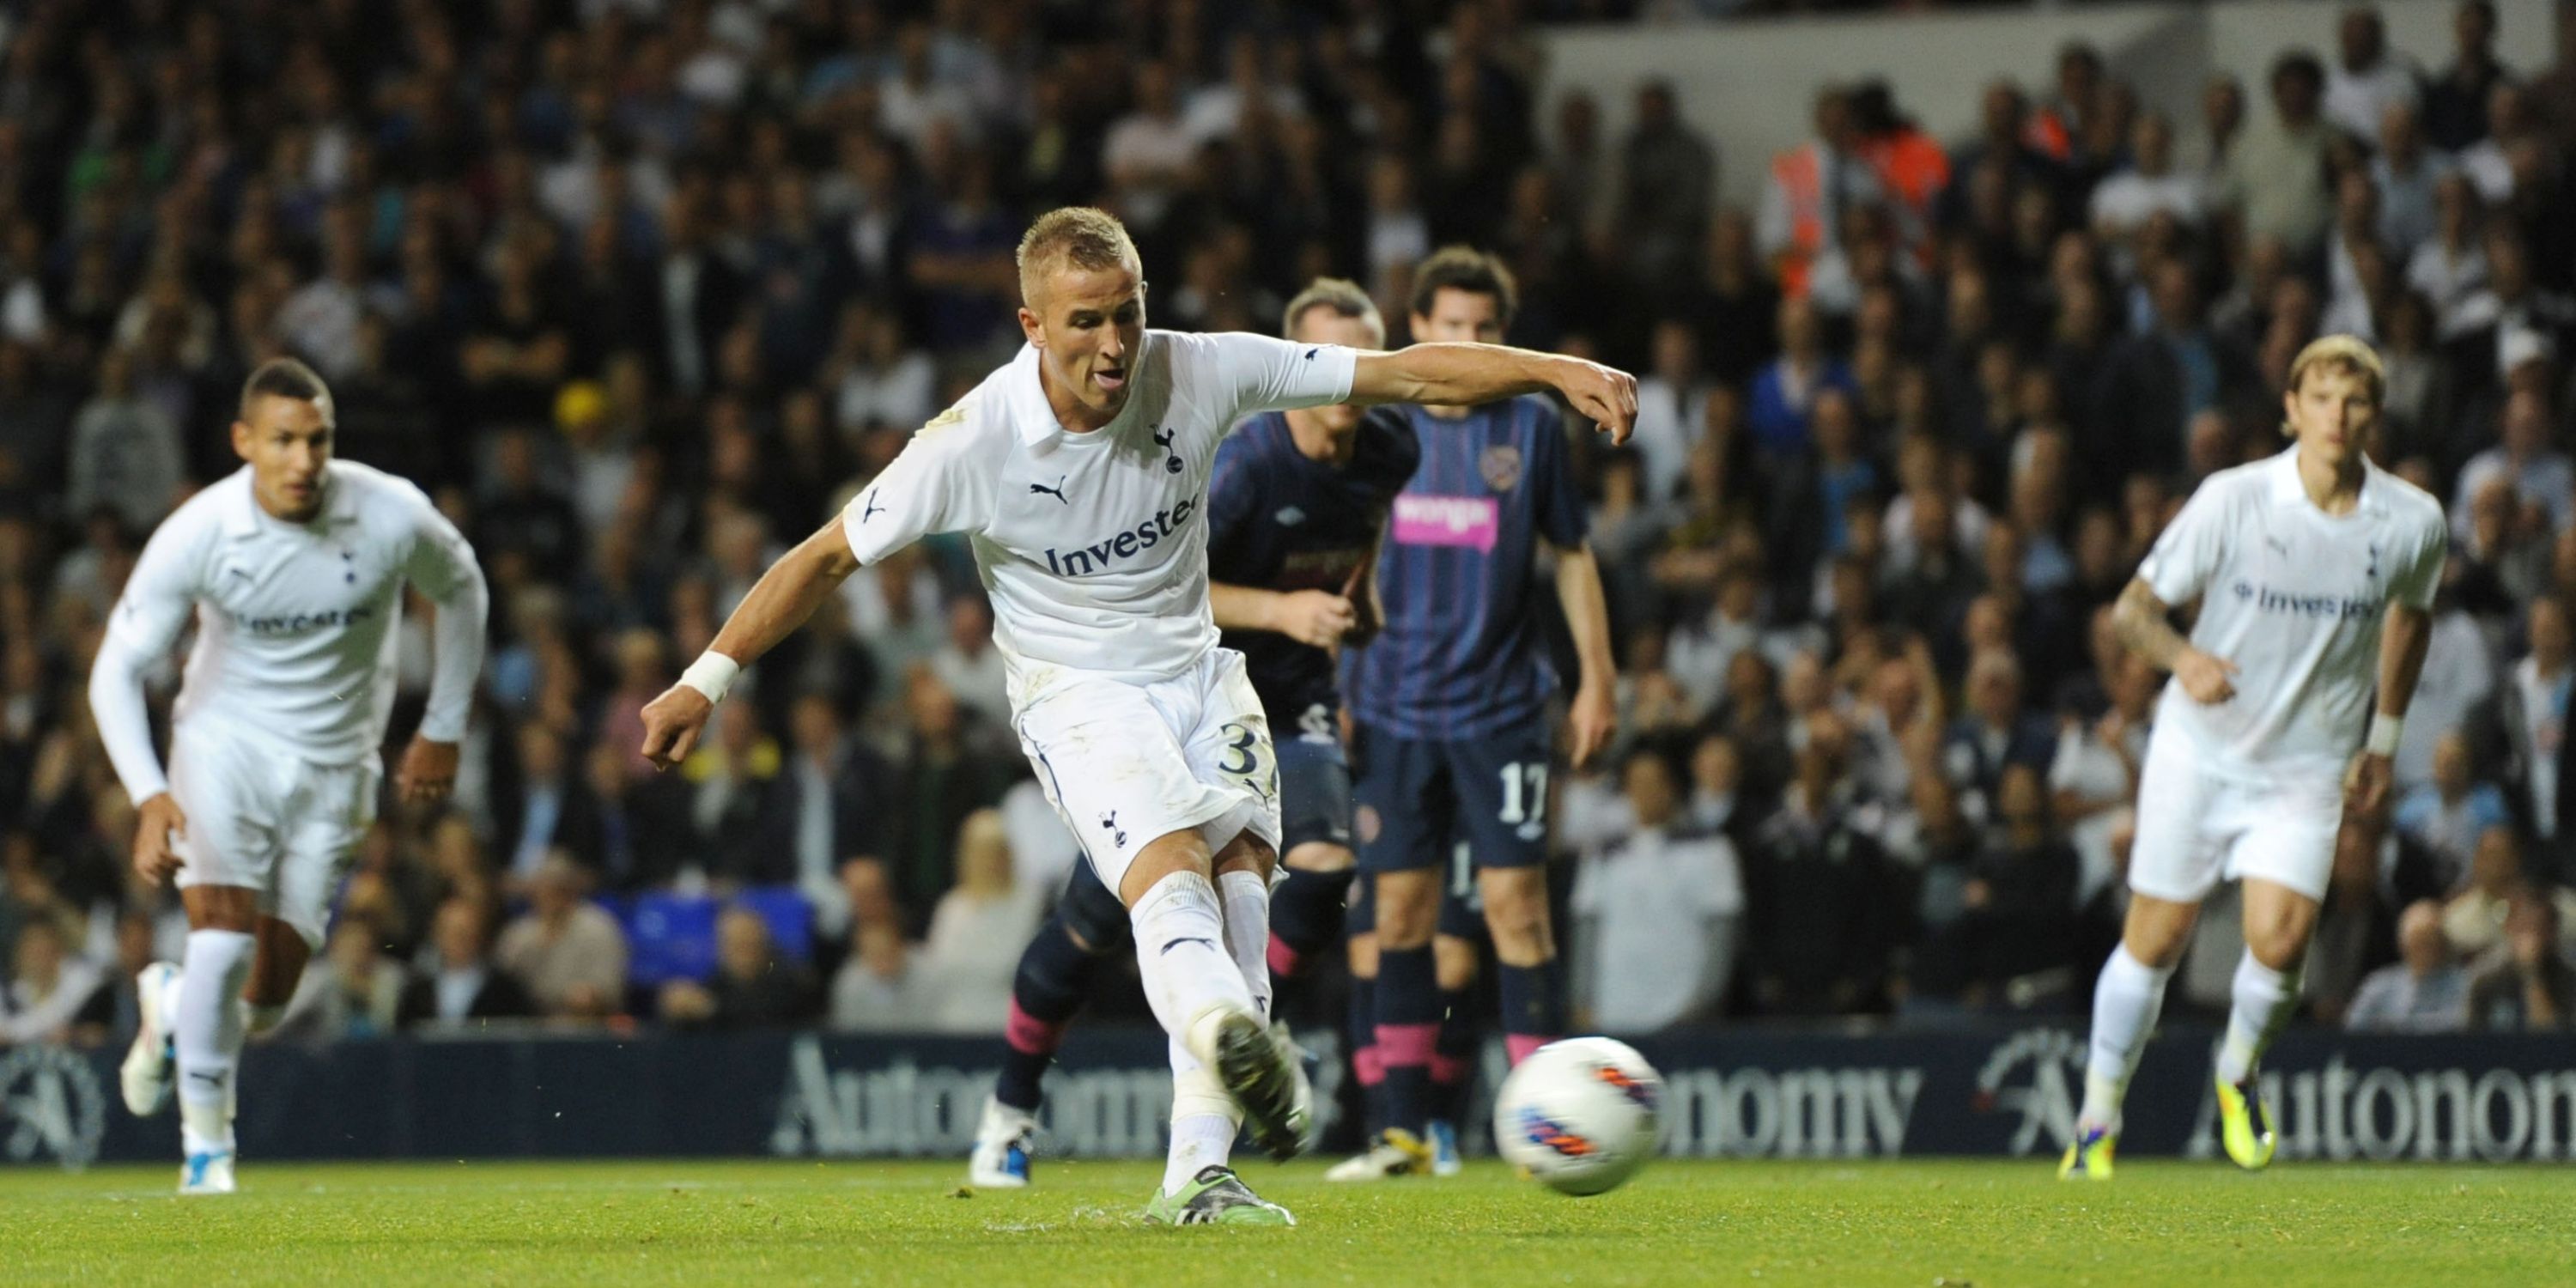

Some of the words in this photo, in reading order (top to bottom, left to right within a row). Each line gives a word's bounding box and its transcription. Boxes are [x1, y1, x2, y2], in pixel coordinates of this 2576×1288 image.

[1218, 722, 1258, 775] 3
[1498, 761, 1548, 824] 17
[773, 1035, 1173, 1156] Autoom
